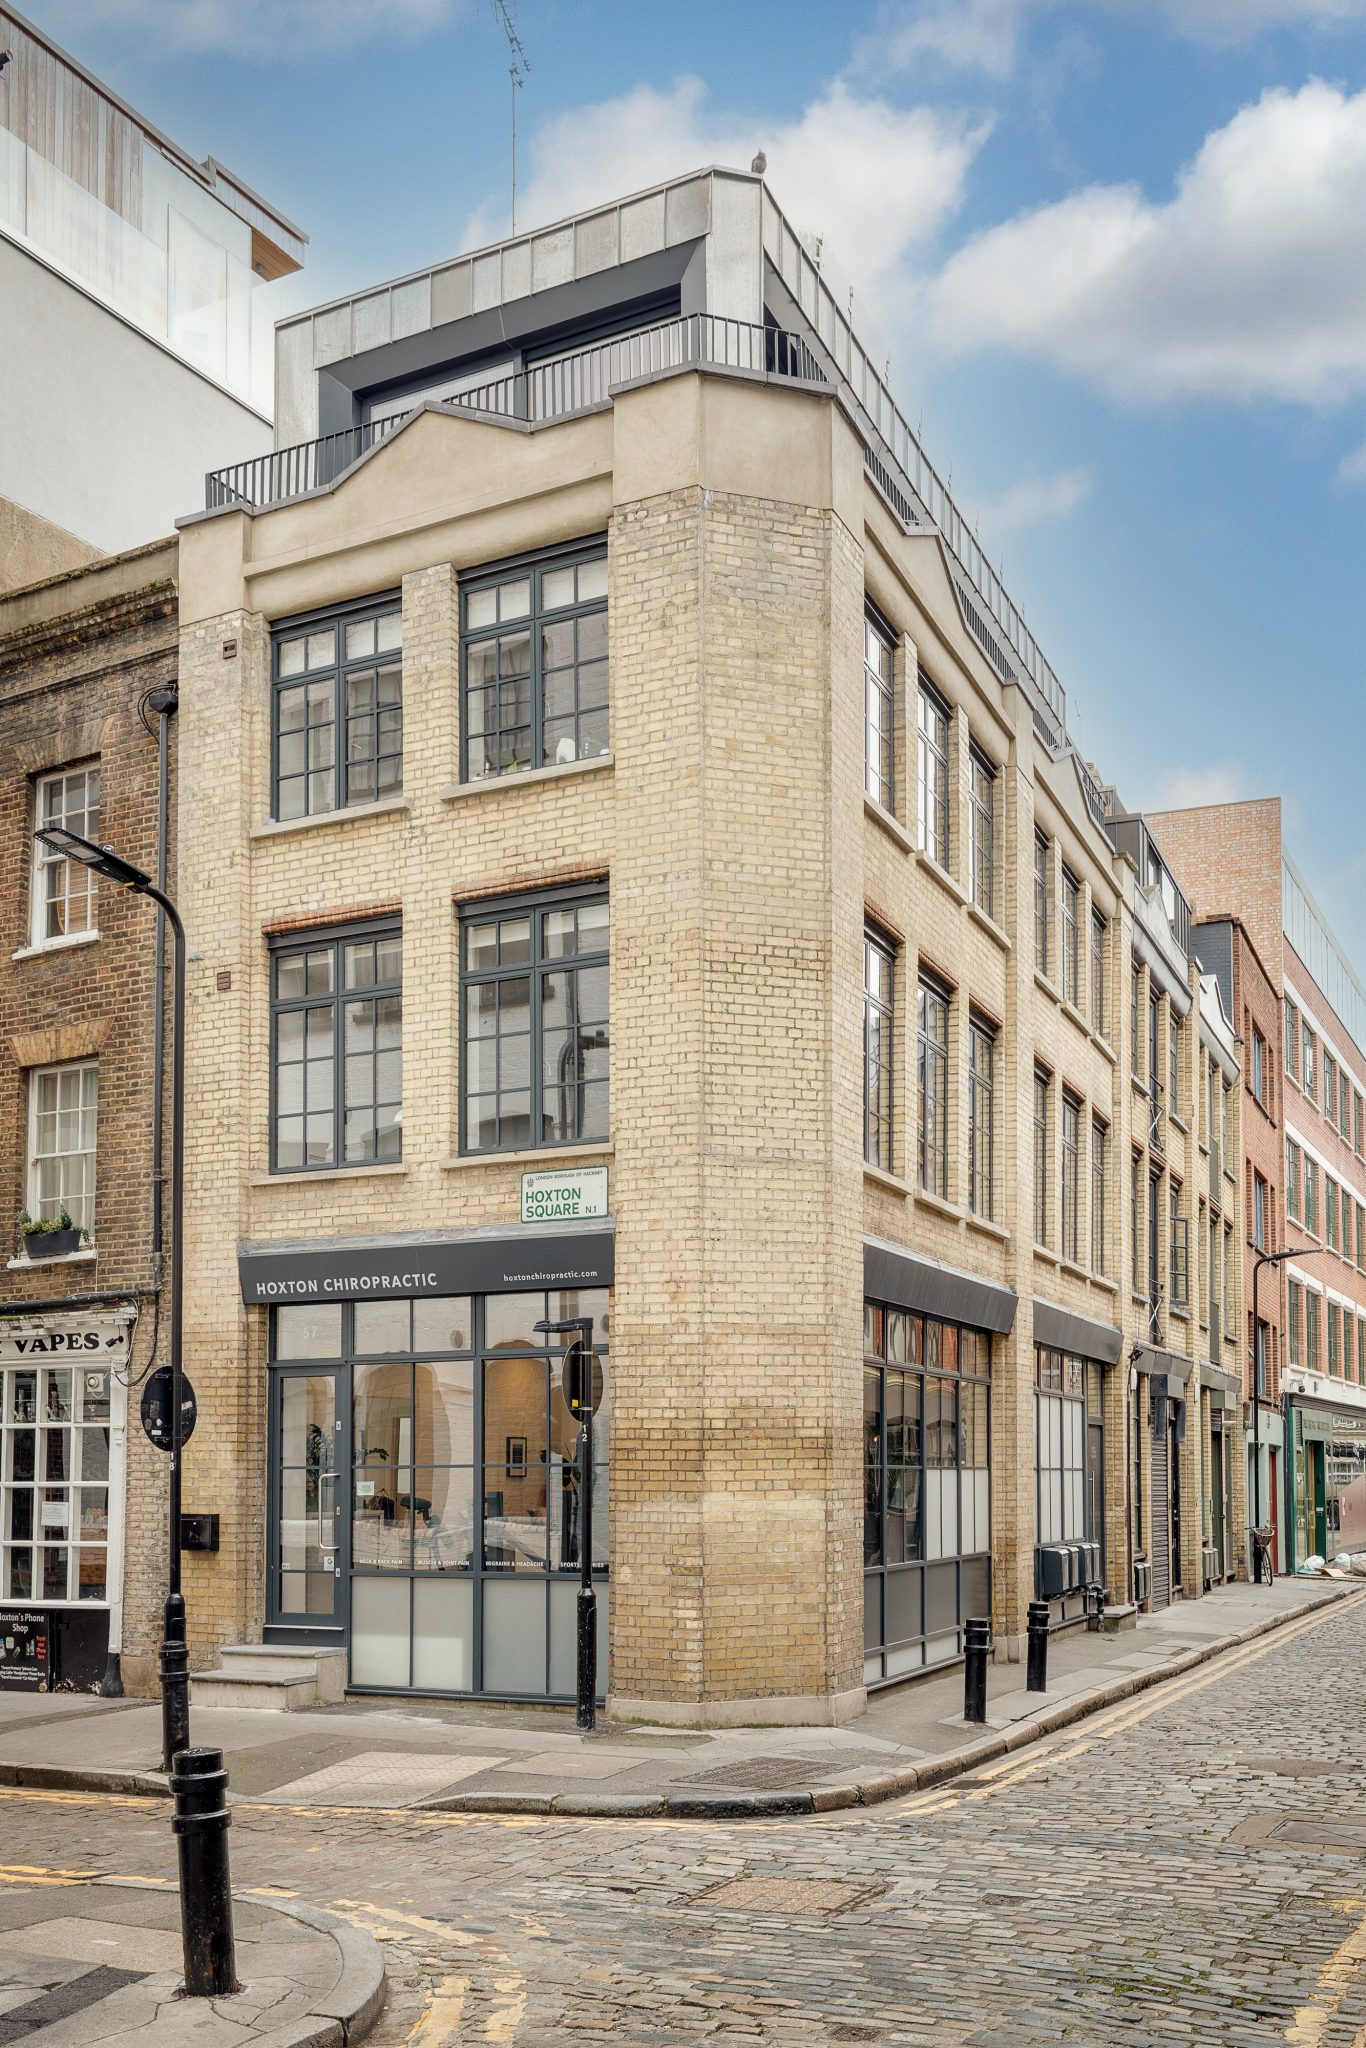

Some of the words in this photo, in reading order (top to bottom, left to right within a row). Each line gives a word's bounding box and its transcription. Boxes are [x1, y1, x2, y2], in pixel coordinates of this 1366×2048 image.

[525, 1187, 581, 1203] HOXTON
[526, 1203, 580, 1218] SQUARE
[503, 1269, 598, 1282] hoxtonchiropractic.com
[256, 1279, 318, 1295] HOXTON
[323, 1272, 438, 1292] CHIROPRACTIC
[14, 1332, 100, 1353] VAPES
[0, 1612, 24, 1622] oxton's
[24, 1613, 45, 1623] Phone
[12, 1623, 29, 1634] Shop
